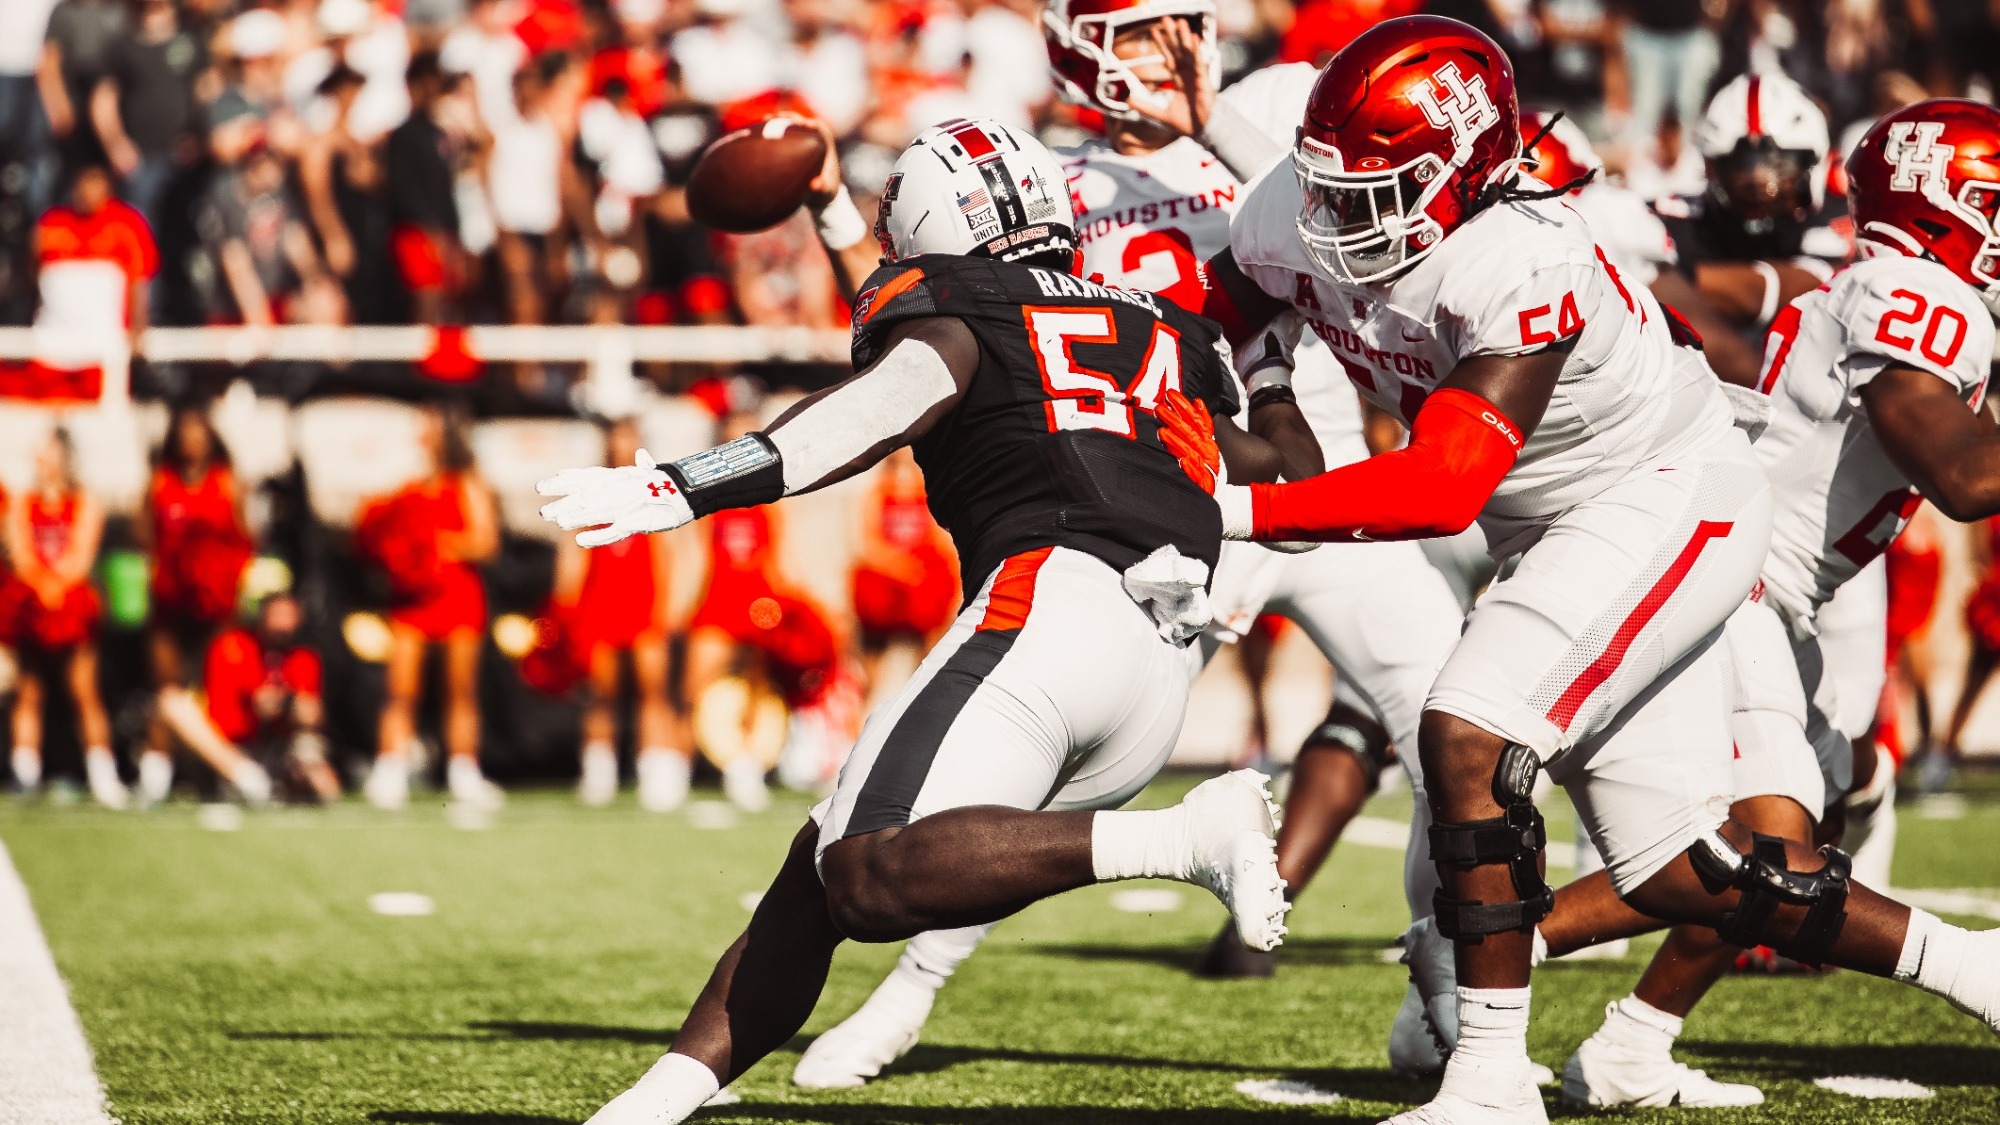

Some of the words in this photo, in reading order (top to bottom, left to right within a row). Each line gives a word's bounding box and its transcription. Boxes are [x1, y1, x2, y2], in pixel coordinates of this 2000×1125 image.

[973, 223, 1000, 242] UNITY
[1079, 185, 1235, 249] HOUSTON
[1306, 316, 1438, 381] HOUSTON
[1518, 290, 1586, 346] 54
[1874, 288, 1968, 368] 20
[1022, 304, 1183, 440] 54
[1481, 411, 1520, 446] PRO
